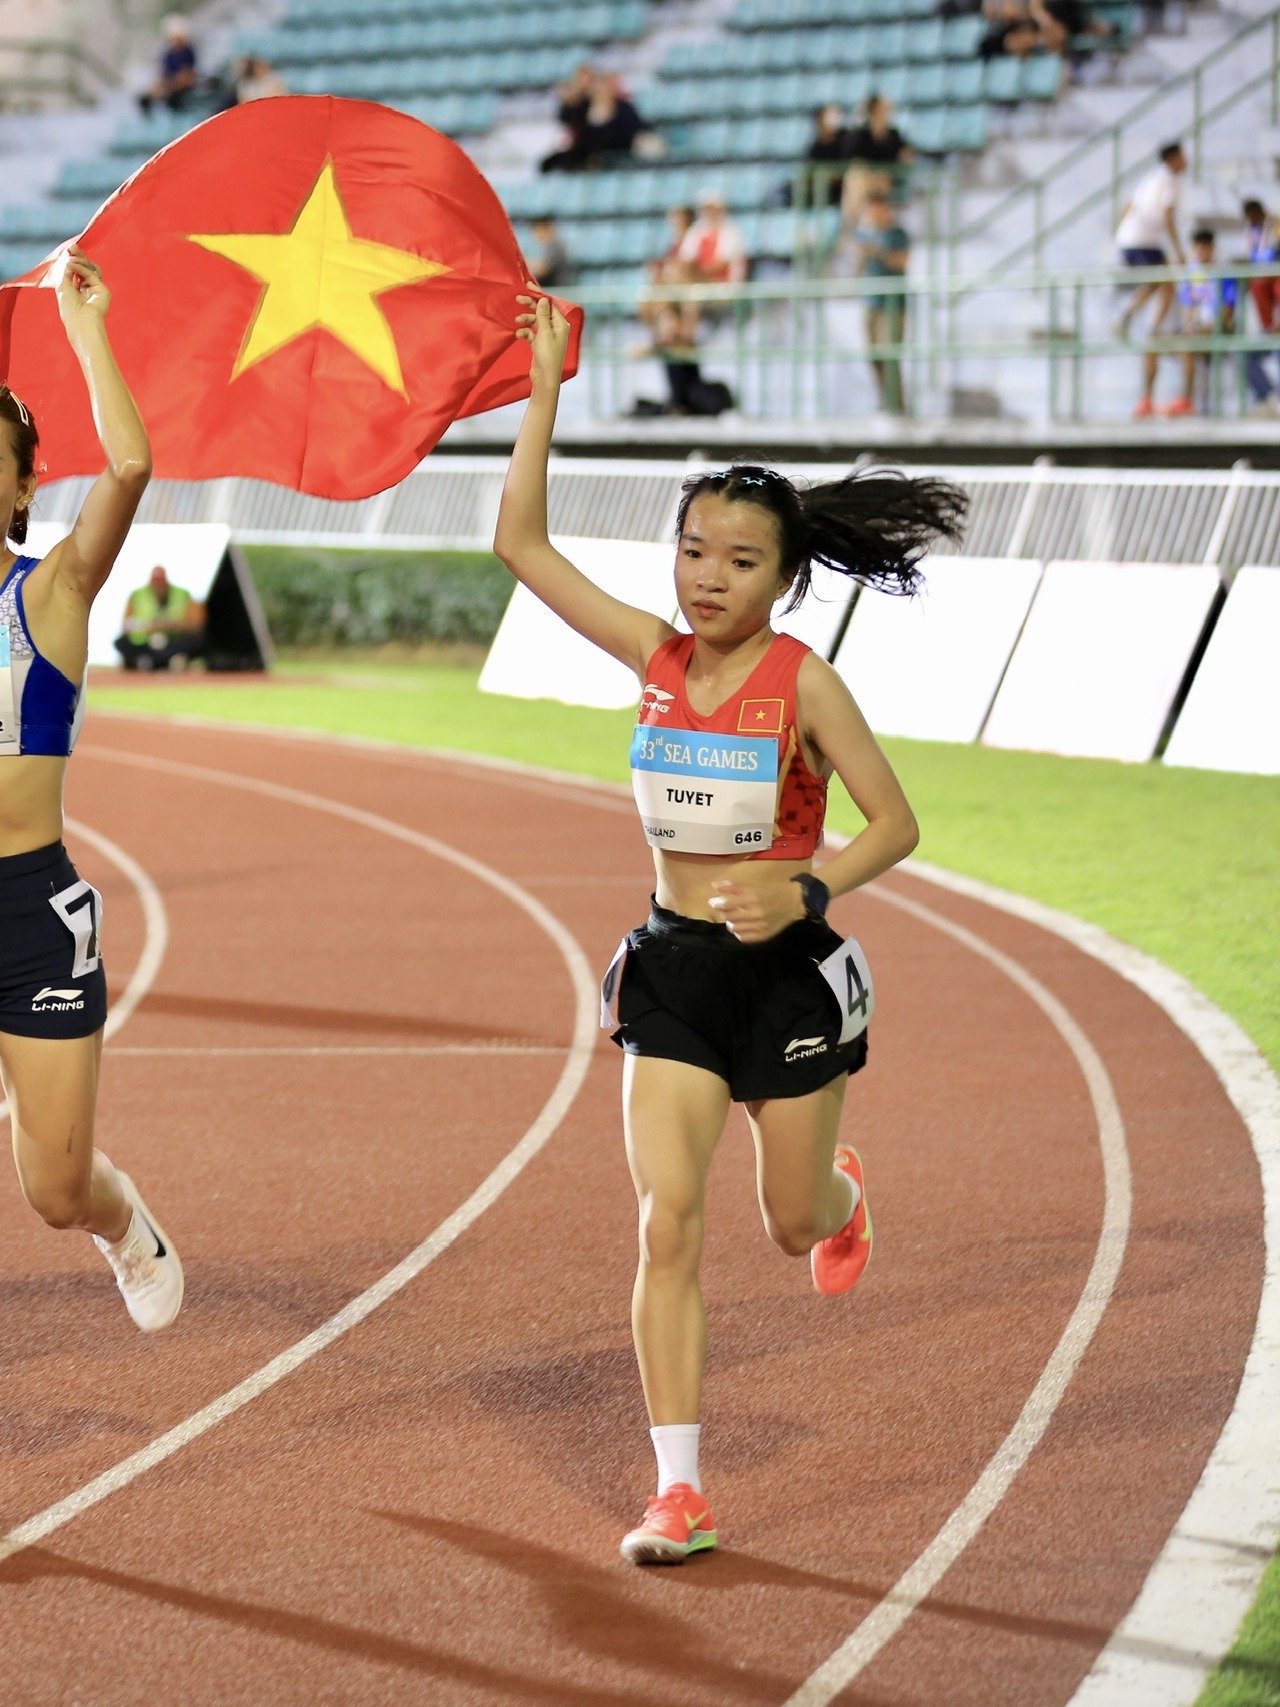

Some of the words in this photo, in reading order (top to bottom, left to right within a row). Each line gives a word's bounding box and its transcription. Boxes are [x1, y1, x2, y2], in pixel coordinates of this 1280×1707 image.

[663, 743, 692, 765] SEA
[697, 747, 759, 771] GAMES
[666, 788, 714, 807] TUYET
[734, 831, 762, 844] 646
[64, 888, 97, 960] 7
[844, 953, 869, 1018] 4
[31, 999, 85, 1012] LI-NING
[785, 1045, 828, 1062] LI-NING
